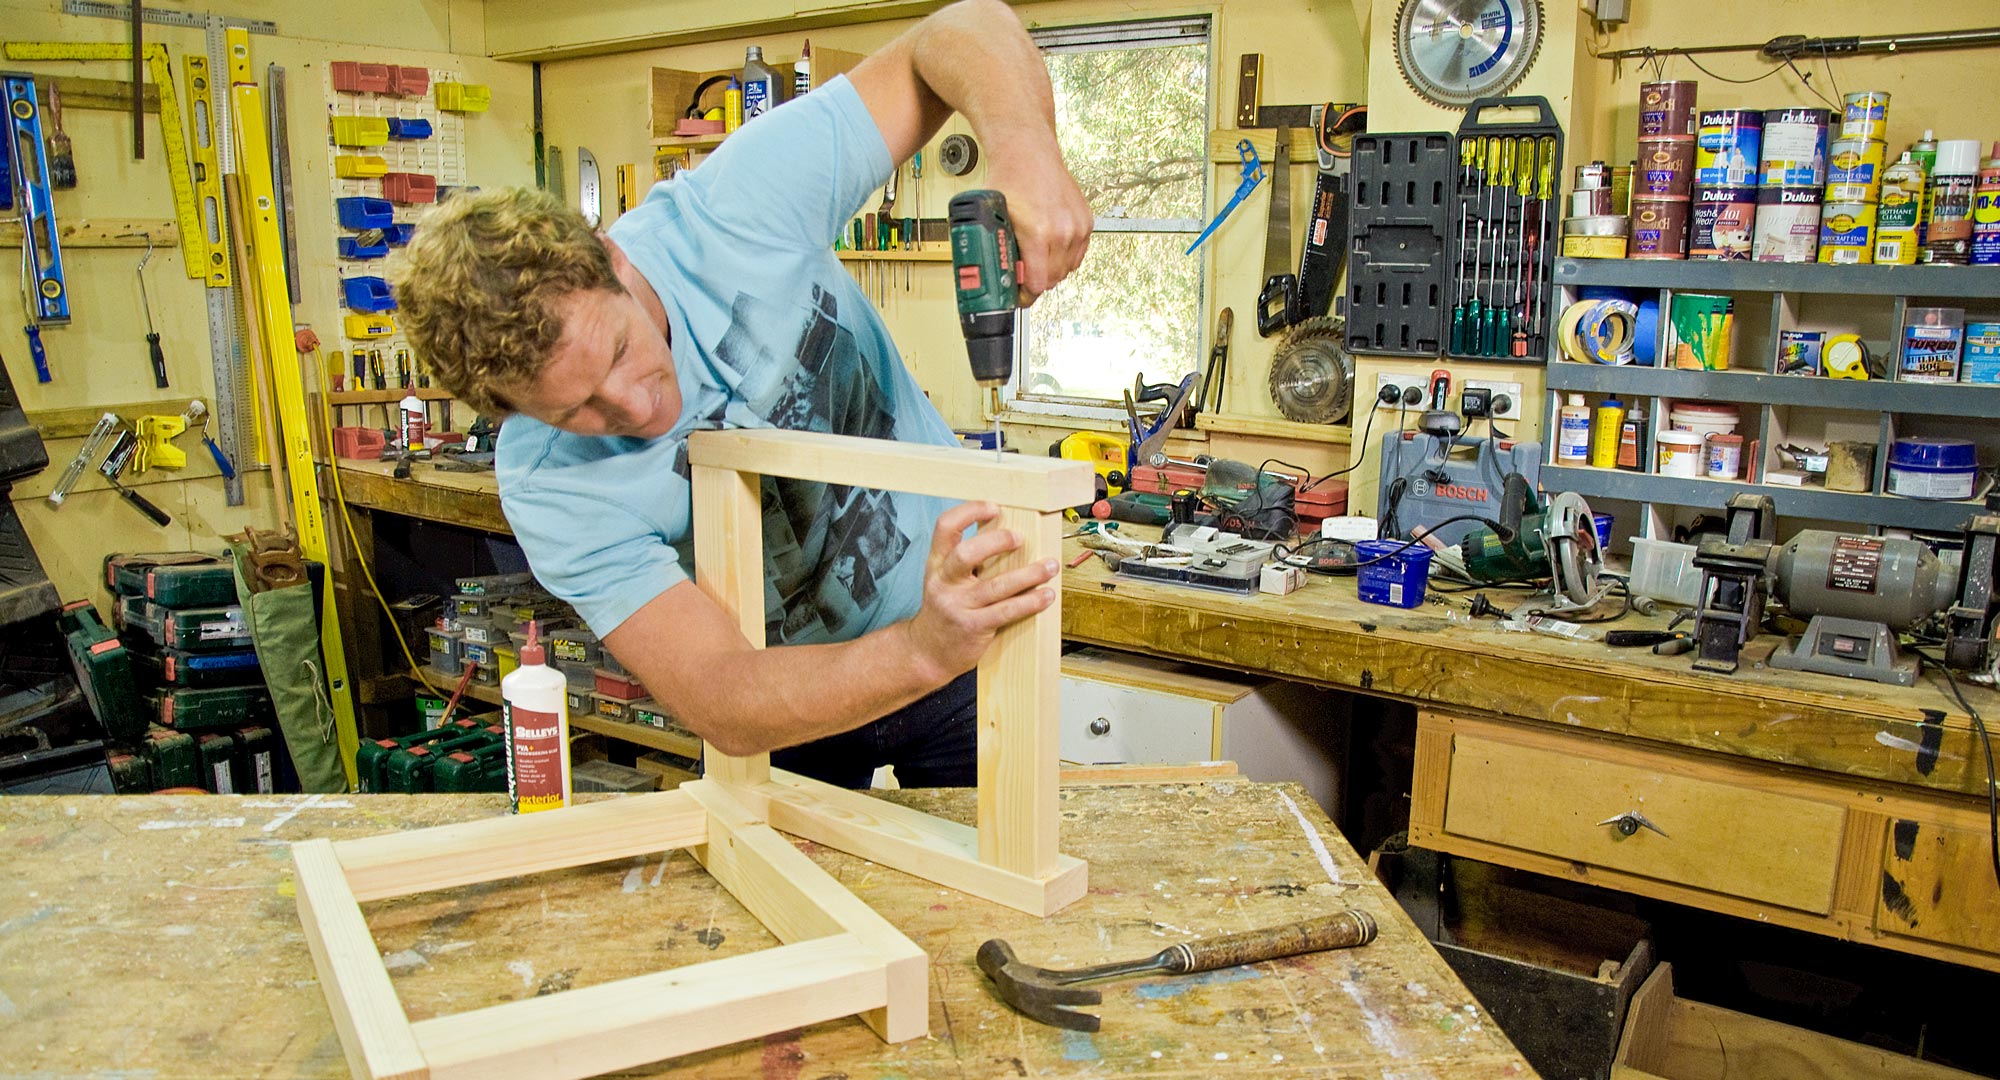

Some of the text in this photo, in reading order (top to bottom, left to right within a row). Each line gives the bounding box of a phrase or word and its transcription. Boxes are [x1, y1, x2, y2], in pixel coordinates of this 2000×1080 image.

[1480, 10, 1501, 20] IRWIN
[1703, 114, 1733, 126] Dulux
[1781, 112, 1816, 123] Dulux
[1702, 191, 1735, 201] Dulux
[1783, 192, 1816, 203] Dulux
[1695, 208, 1740, 220] Wash& 101
[1695, 217, 1713, 226] Wear
[998, 229, 1009, 270] BOSCH
[1907, 338, 1957, 351] TURBO
[1435, 483, 1489, 503] BOSCH
[1318, 557, 1345, 565] BOSCH
[515, 725, 558, 738] SELLEYS
[519, 793, 560, 805] exterior
